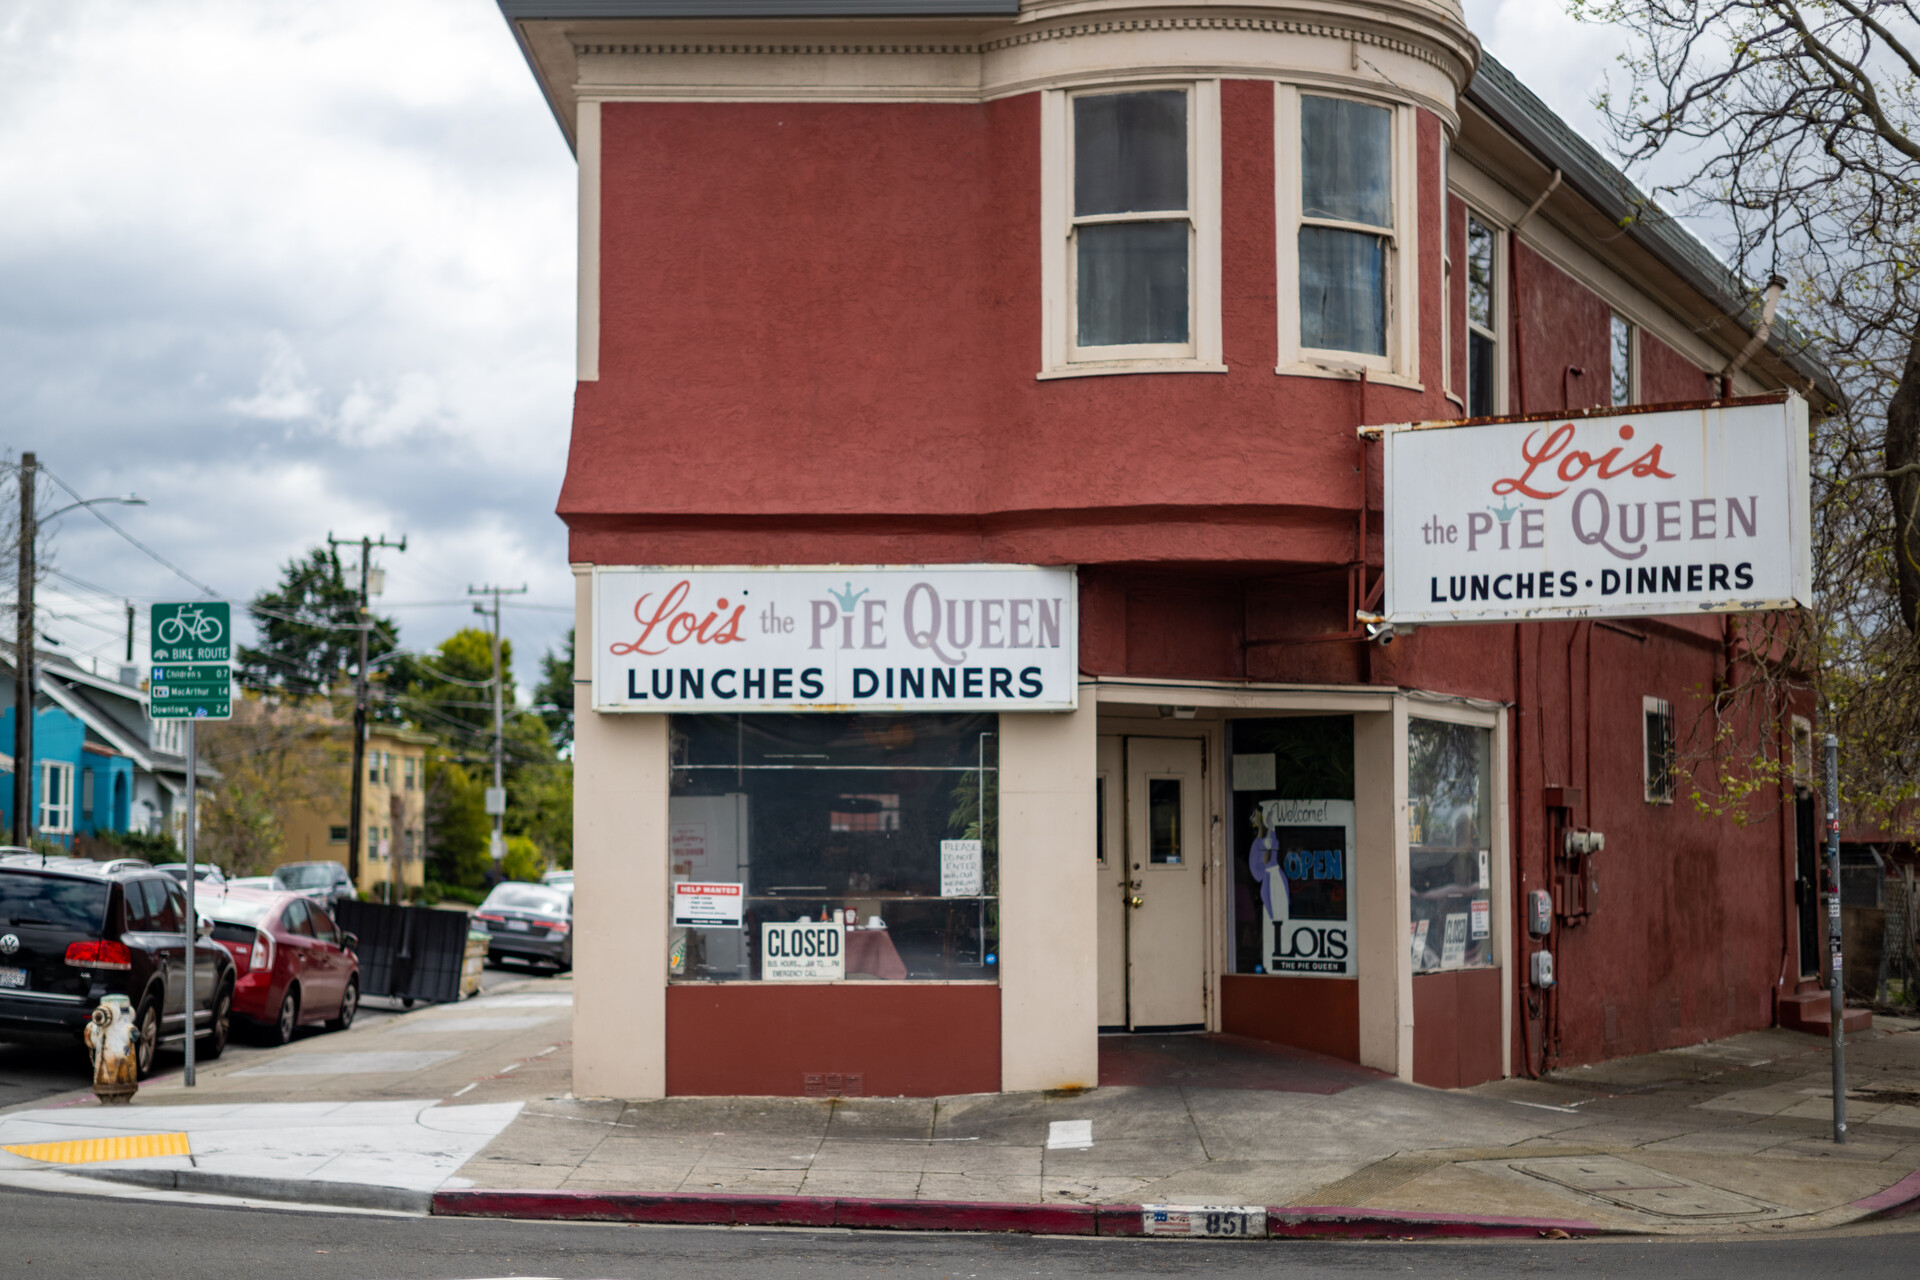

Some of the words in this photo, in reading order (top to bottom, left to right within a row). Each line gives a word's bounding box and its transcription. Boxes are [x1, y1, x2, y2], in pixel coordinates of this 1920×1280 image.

[1491, 422, 1677, 500] Lois
[1420, 514, 1459, 545] the
[1466, 507, 1545, 552] PIE
[1571, 487, 1759, 561] QUEEN
[1431, 569, 1578, 603] LUNCHES
[1600, 562, 1755, 596] DINNERS
[609, 579, 747, 656] Lois
[759, 602, 795, 635] the
[807, 599, 888, 650] PIE
[902, 581, 1064, 666] QUEEN
[172, 648, 194, 660] BIKE
[198, 647, 229, 659] ROUTE
[171, 686, 210, 696] MacArthur
[627, 666, 825, 700] LUNCHES
[851, 665, 1044, 699] DINNERS
[152, 704, 189, 714] Downtown
[1272, 801, 1329, 824] Welcome!
[944, 842, 979, 852] PLEASE
[1284, 850, 1343, 880] OPEN
[679, 885, 702, 894] HELP
[703, 886, 738, 895] WANTED
[767, 928, 839, 957] CLOSED
[1272, 920, 1348, 960] LOIS
[1281, 961, 1297, 970] THE
[1297, 961, 1310, 970] PIE
[1312, 962, 1339, 971] QUEEN
[1205, 1211, 1247, 1235] 851
